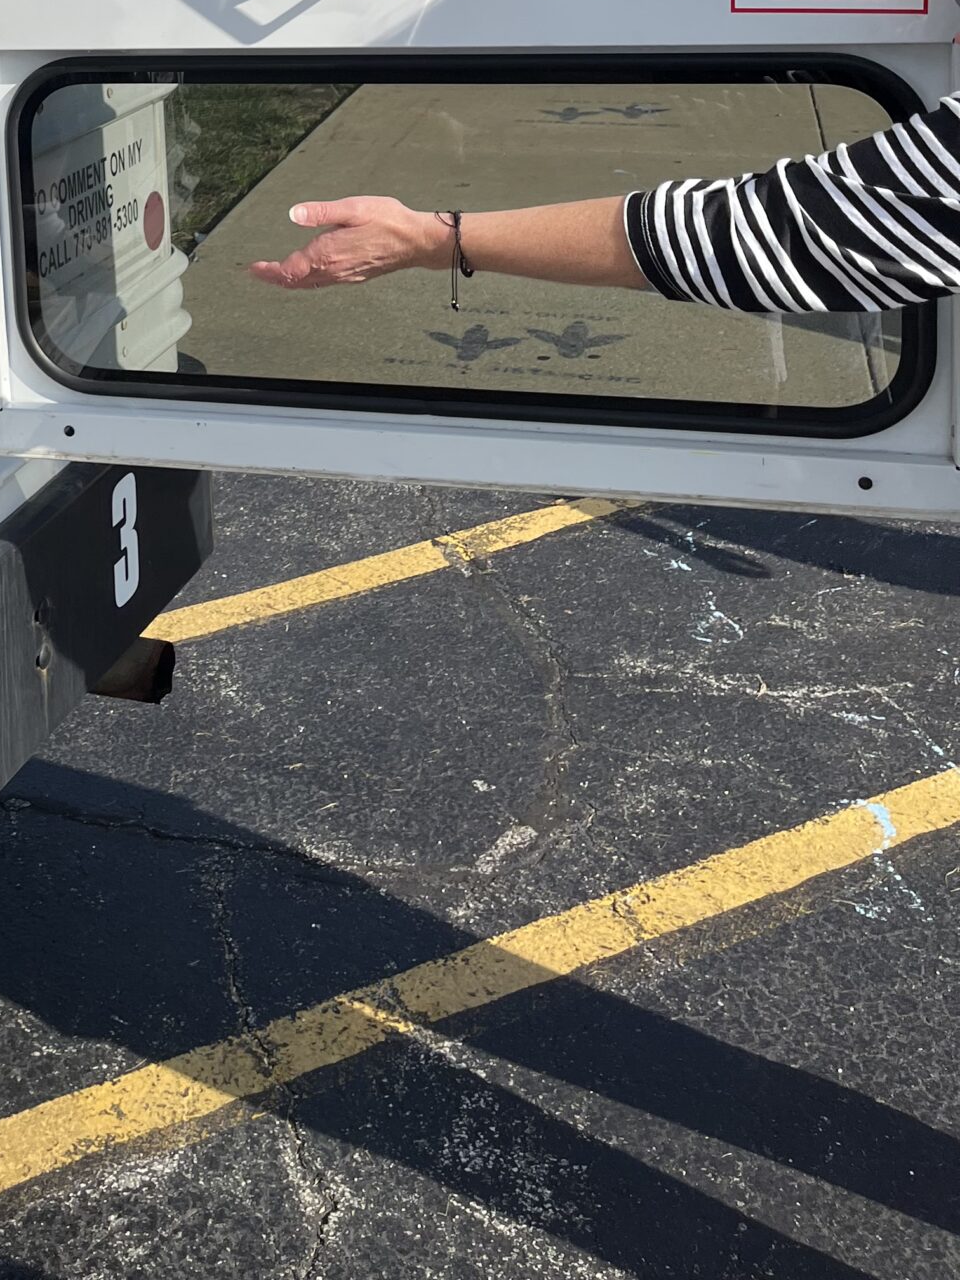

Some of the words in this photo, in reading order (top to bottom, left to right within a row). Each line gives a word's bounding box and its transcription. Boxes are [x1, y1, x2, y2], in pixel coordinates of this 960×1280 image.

[50, 156, 107, 210] COMMENT
[110, 148, 126, 177] ON
[127, 138, 143, 169] MY
[68, 183, 114, 231] DRIVING
[39, 239, 72, 279] CALL
[111, 471, 140, 608] 3
